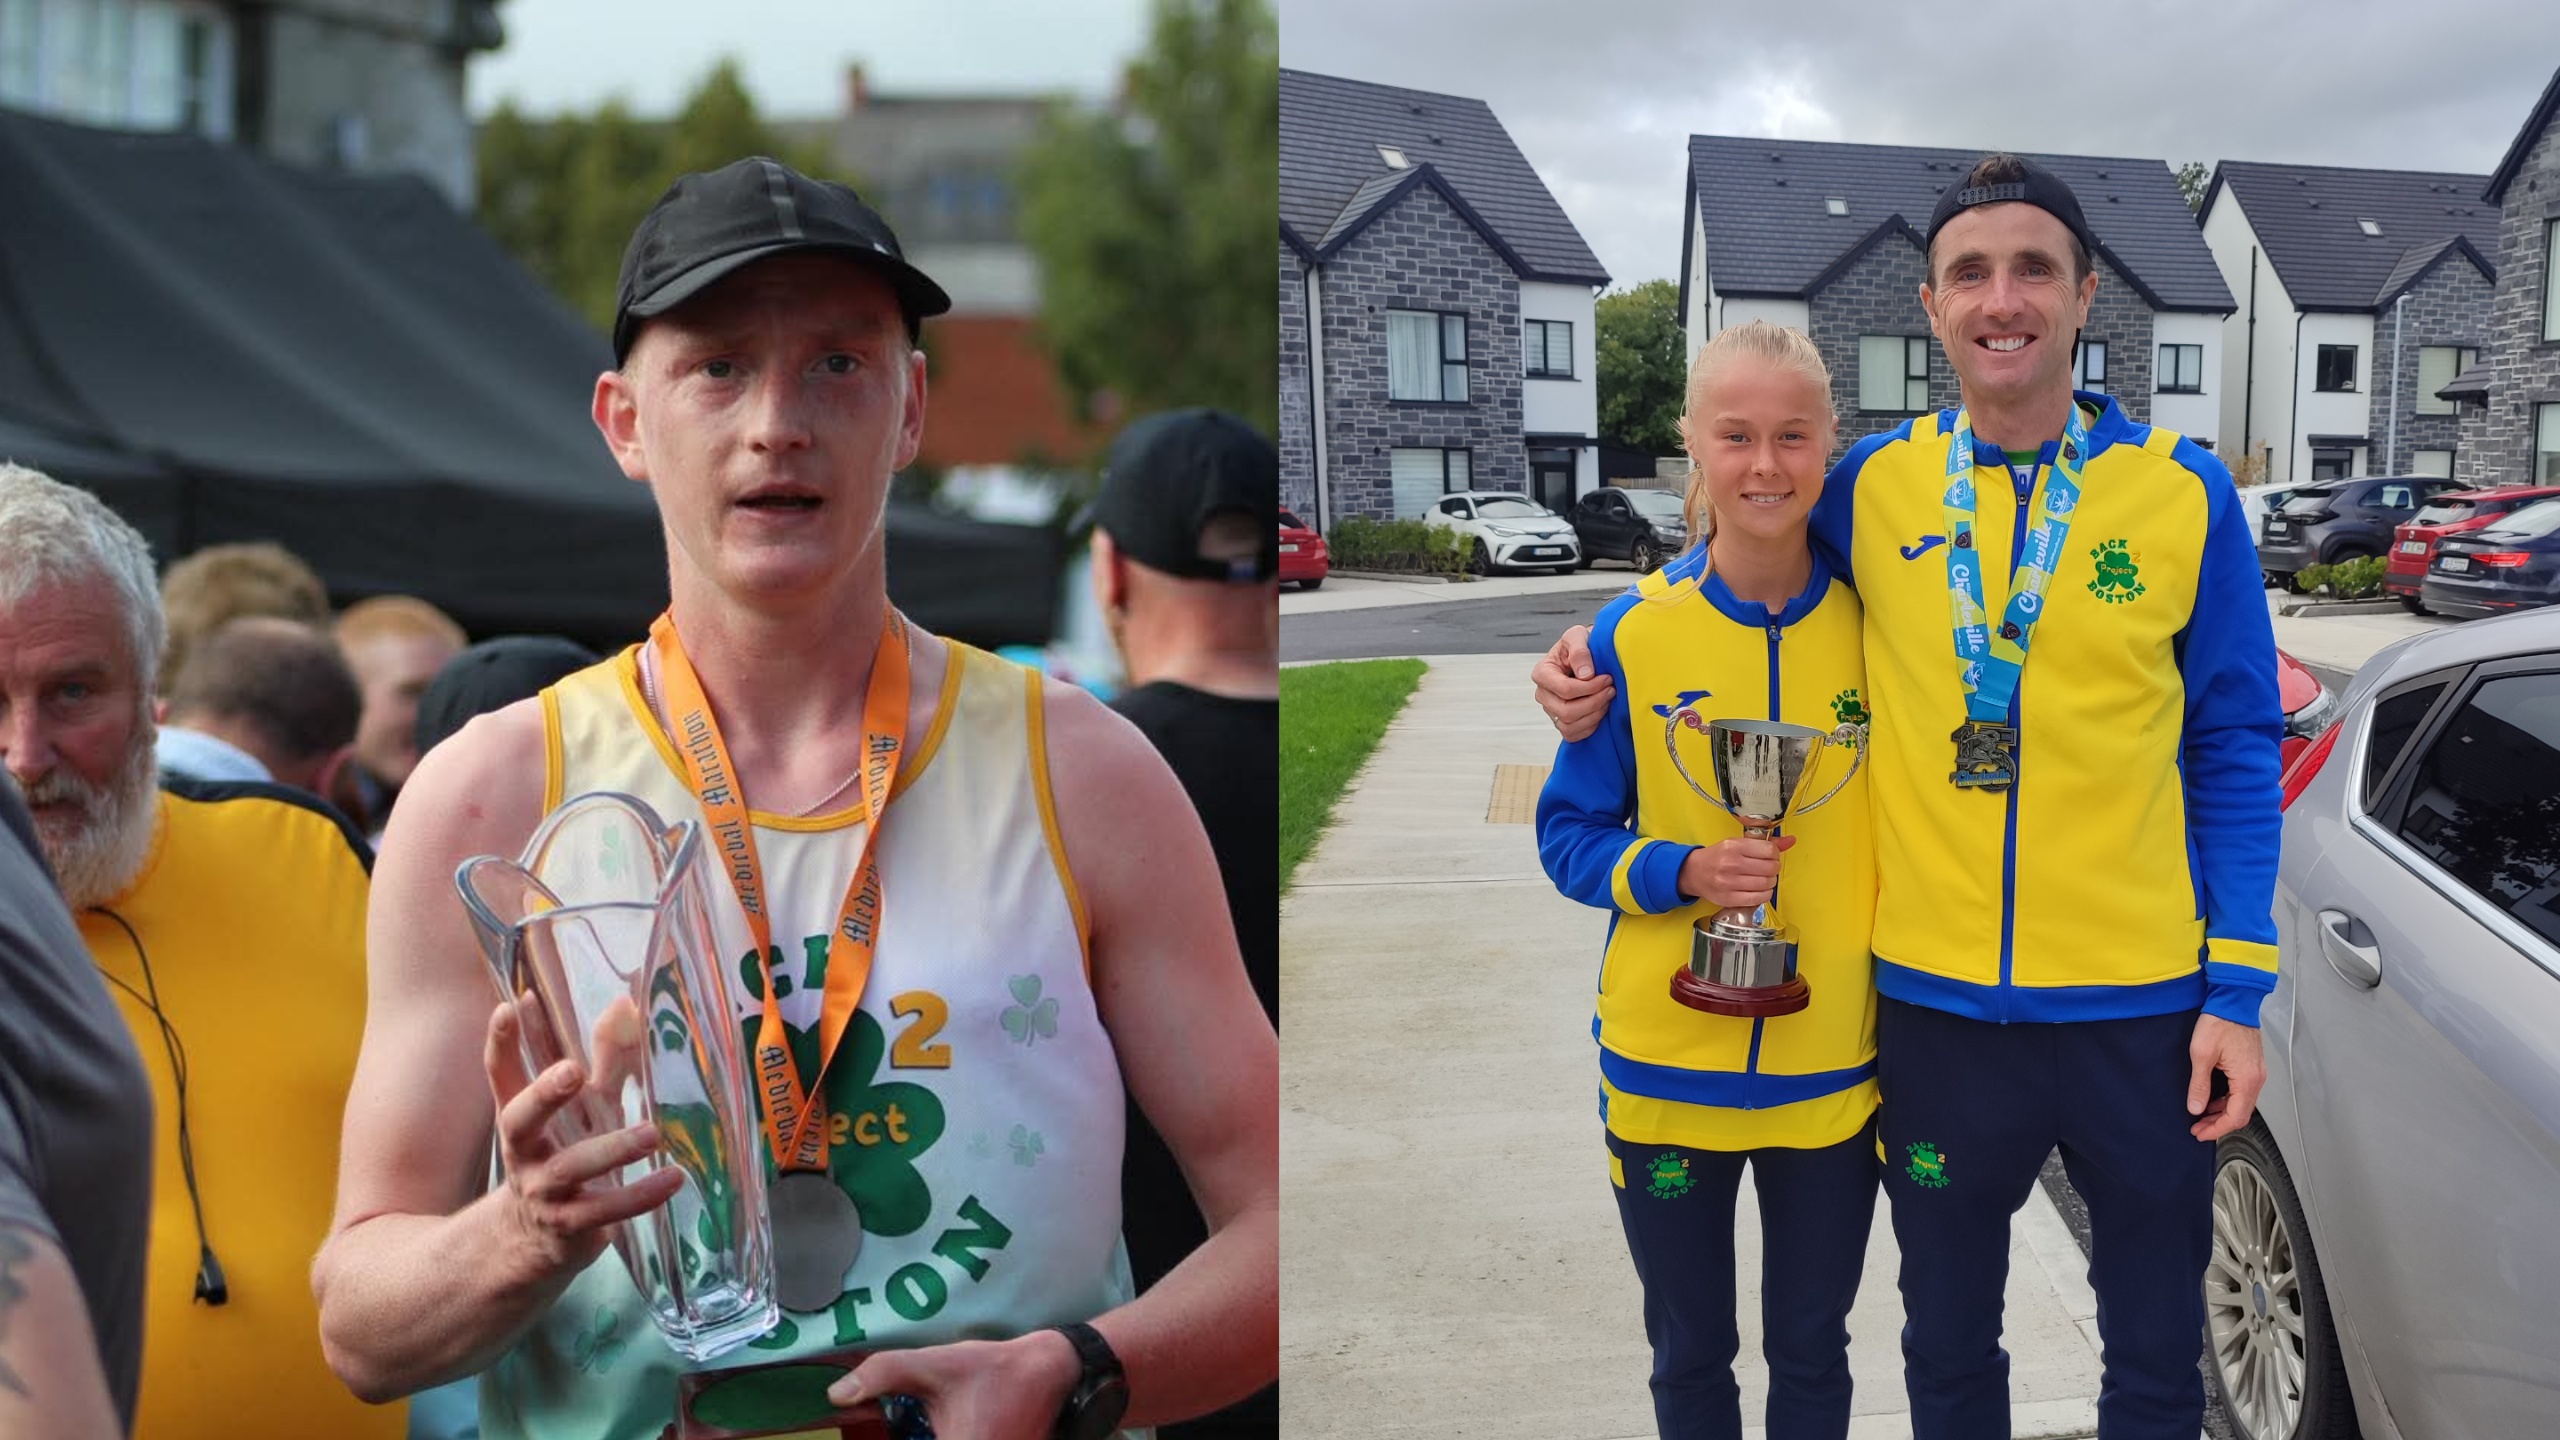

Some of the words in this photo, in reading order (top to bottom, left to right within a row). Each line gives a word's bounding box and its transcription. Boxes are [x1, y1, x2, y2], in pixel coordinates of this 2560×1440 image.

[2090, 539, 2128, 560] BACK
[2131, 551, 2142, 564] 2
[2018, 520, 2053, 614] Charleville
[2100, 563, 2133, 576] Project
[2086, 580, 2147, 604] BOSTON
[1951, 563, 1985, 655] Charleville
[1830, 689, 1859, 711] BACK
[683, 708, 737, 807] Marathon
[714, 819, 765, 920] Medieval
[888, 989, 952, 1070] 2
[1905, 1141, 1936, 1155] BACK
[1937, 1153, 1946, 1164] 2
[1645, 1152, 1678, 1172] BACK
[1681, 1158, 1690, 1168] 2
[1656, 1171, 1684, 1179] Project
[1904, 1166, 1951, 1188] BOSTON
[1645, 1178, 1698, 1200] BOSTON
